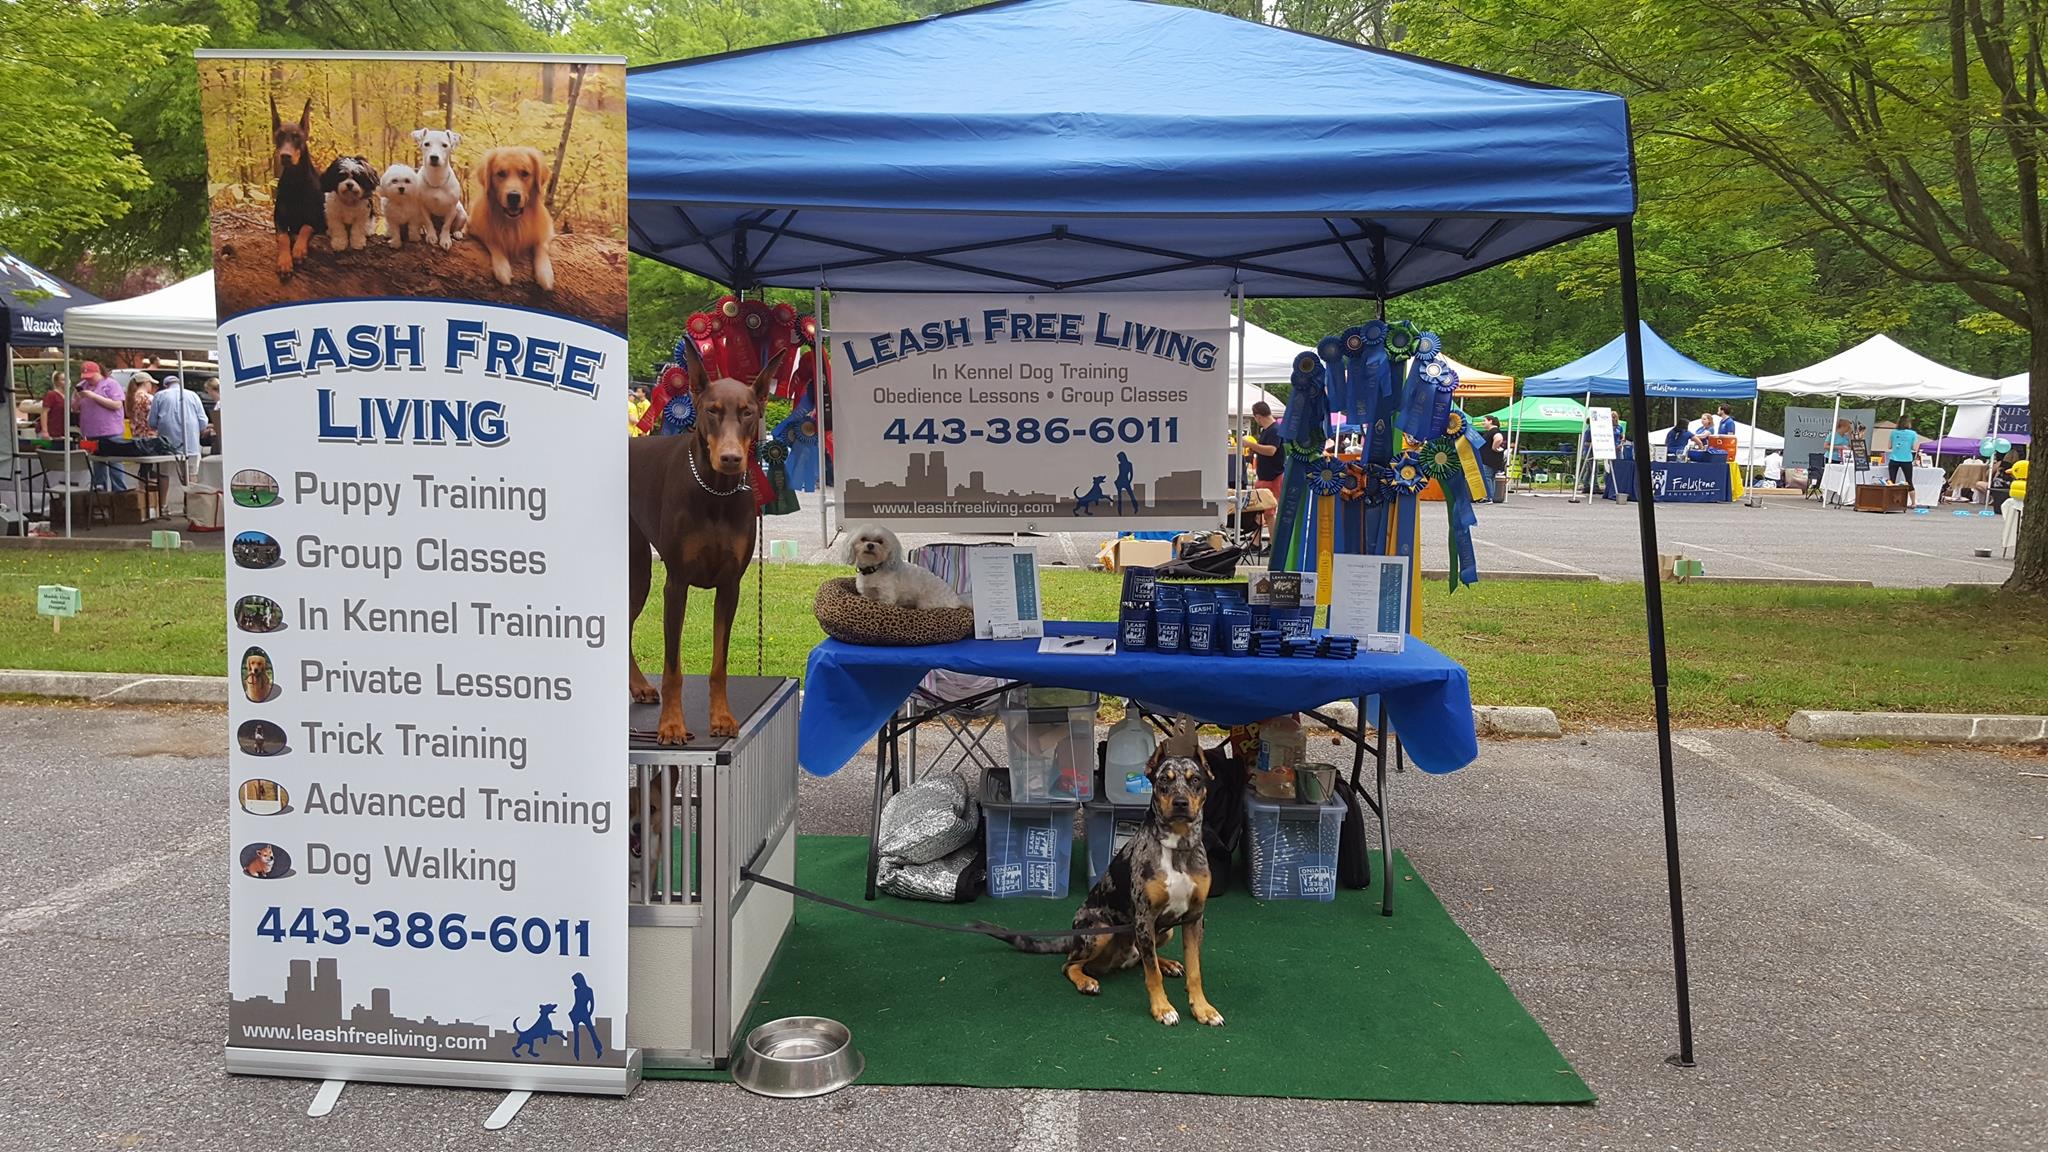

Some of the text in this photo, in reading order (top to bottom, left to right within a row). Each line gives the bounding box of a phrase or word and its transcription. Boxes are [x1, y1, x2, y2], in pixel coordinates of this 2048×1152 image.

[226, 318, 606, 400] LEASH FREE
[842, 308, 1219, 375] LEASH FREE LIVING
[873, 385, 1189, 404] Obedience Lessons Group Classes
[933, 363, 1128, 384] In Kennel Dog Training
[316, 388, 510, 448] LIVING
[884, 416, 1179, 444] 443-386-6011
[294, 472, 547, 521] Puppy Training
[1672, 478, 1715, 490] Fieldstone
[873, 502, 1055, 516] www.leashfreeliving.com
[296, 535, 547, 577] Group Classes
[298, 598, 606, 648] In Kennel Training
[300, 660, 572, 701] Private Lessons
[301, 722, 527, 769] Trick Training
[303, 783, 611, 833] Advanced Training
[307, 843, 517, 891] Dog Walking
[1033, 835, 1041, 855] FREE
[256, 906, 590, 956] 443-386-6011
[242, 1024, 488, 1051] www.leashfreeliving.com
